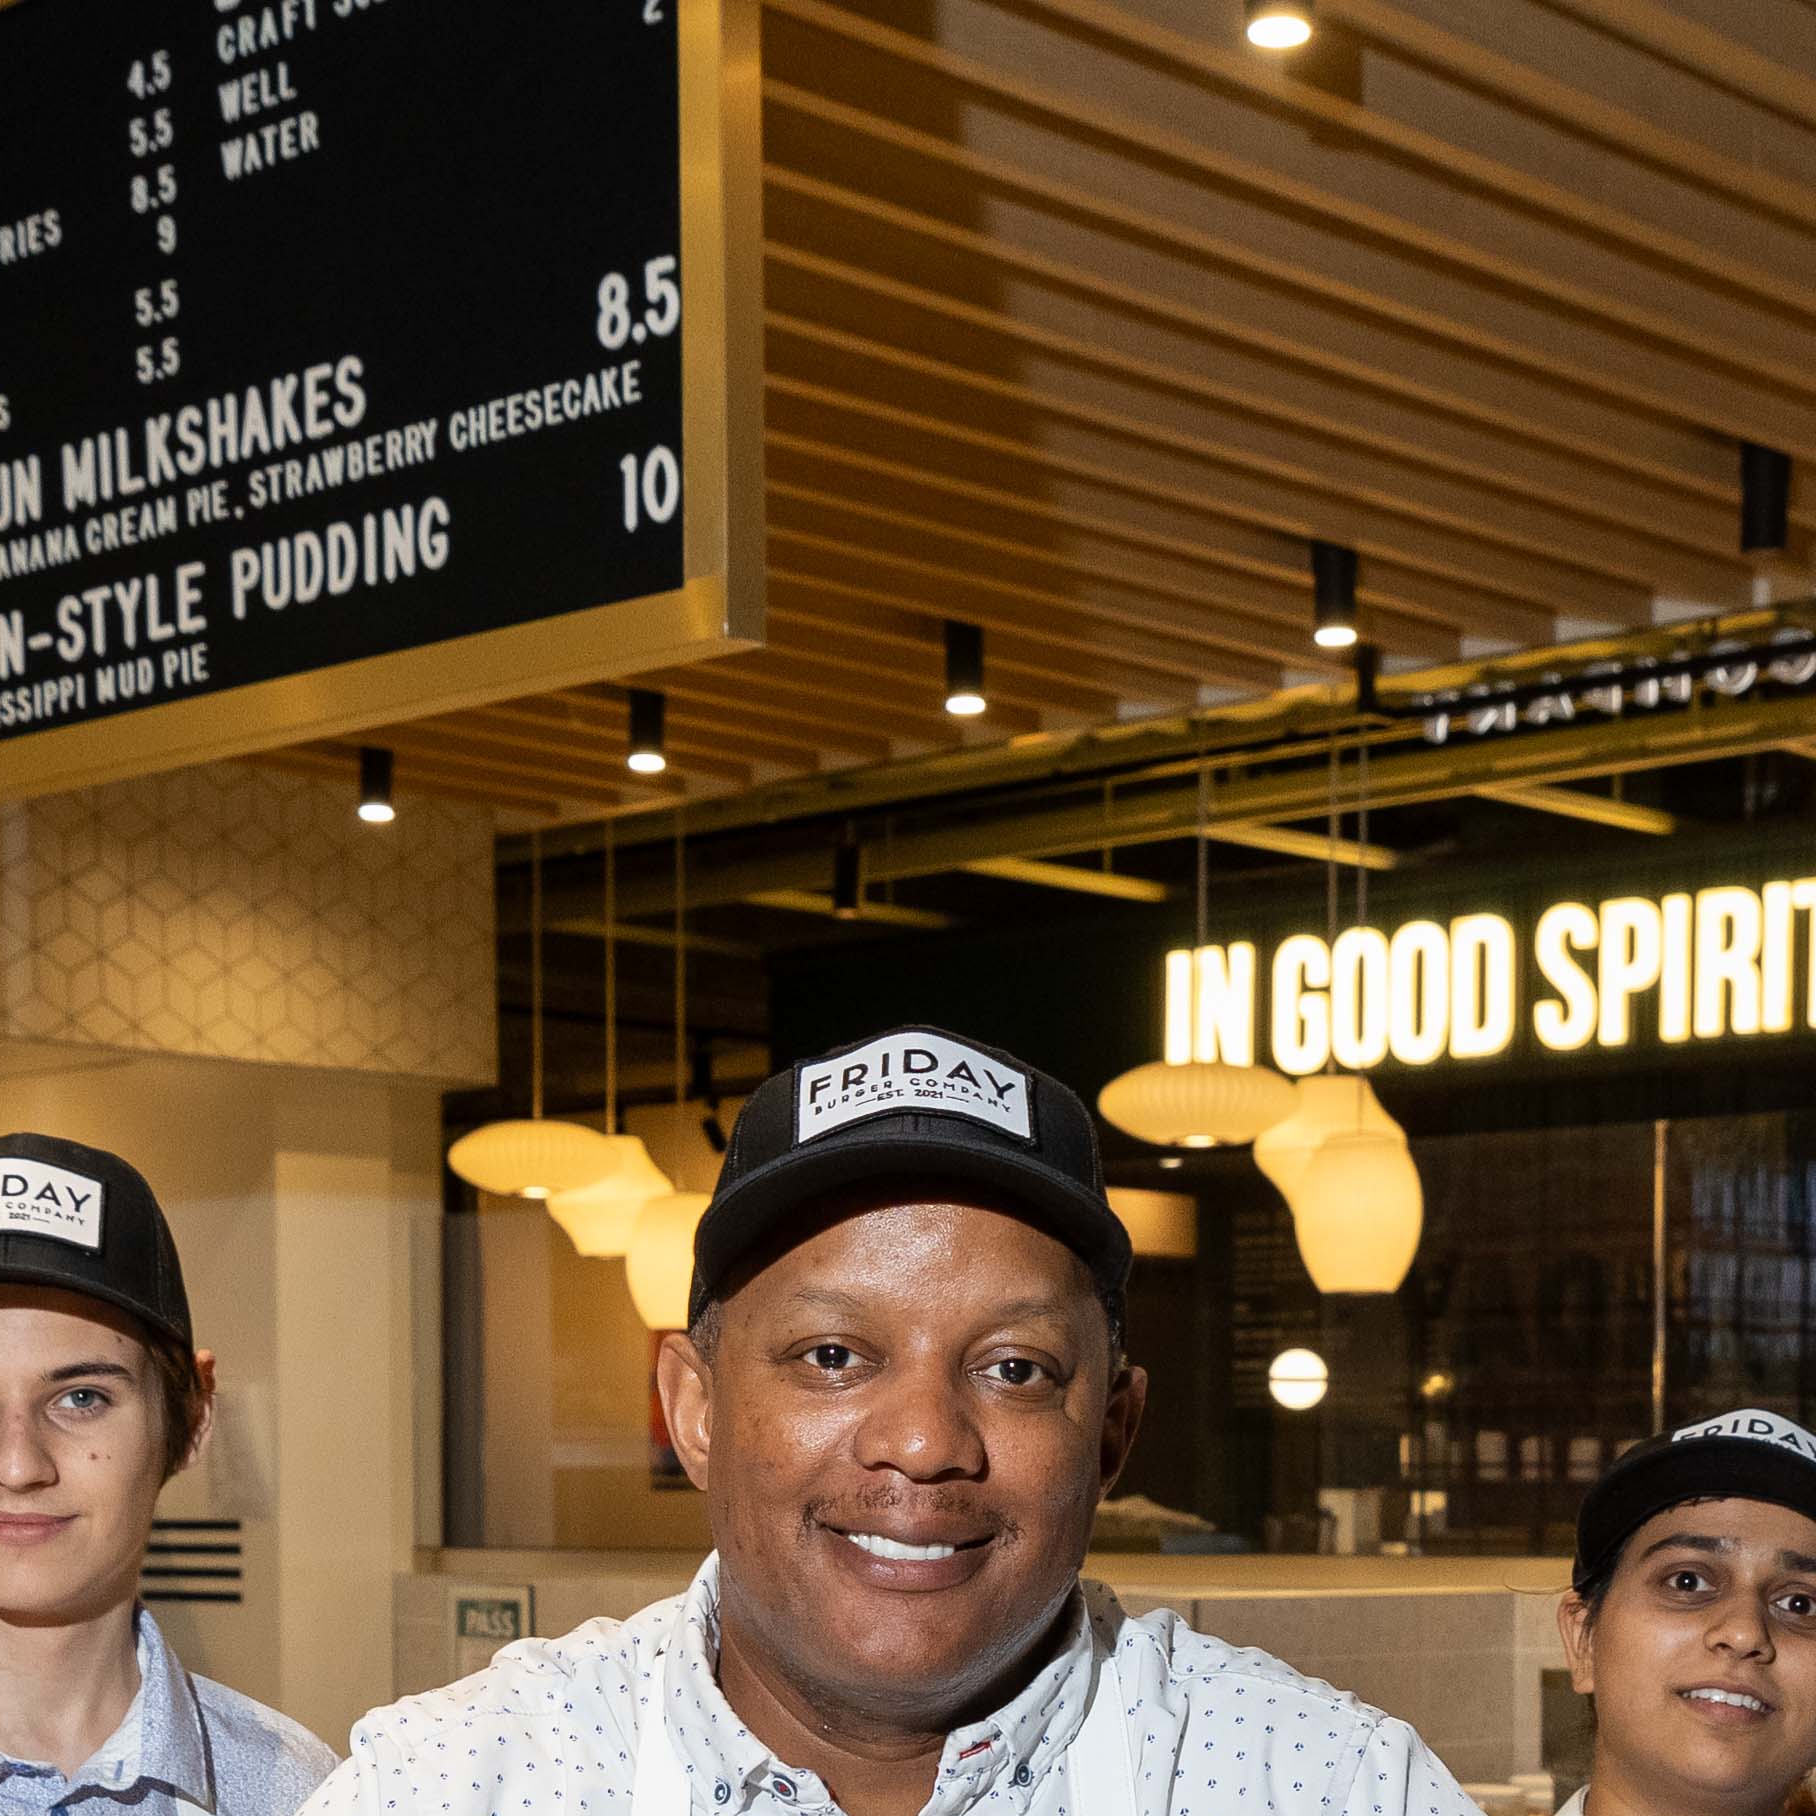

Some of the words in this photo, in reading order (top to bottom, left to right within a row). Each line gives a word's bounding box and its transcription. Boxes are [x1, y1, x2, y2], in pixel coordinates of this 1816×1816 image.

[217, 0, 317, 63] CRAFT
[128, 46, 171, 104] 4.5
[218, 62, 296, 122] WELL
[129, 103, 173, 161] 5.5
[221, 112, 319, 180] WATER
[131, 161, 176, 217] 8.5
[157, 211, 177, 258] 9
[135, 276, 179, 330] 5.5
[62, 351, 366, 515] MILKSHAKES
[596, 251, 680, 355] 8.5
[136, 335, 180, 388] 5.5
[85, 494, 177, 557] CREAM
[249, 419, 438, 511] STRAWBERRY
[450, 357, 642, 454] CHEESECAKE
[229, 492, 451, 622] PUDDING
[620, 440, 680, 535] 10
[95, 654, 155, 705] MUD
[163, 640, 210, 689] PIE
[1165, 942, 1255, 1069] IN
[1271, 912, 1515, 1076] GOOD
[810, 1049, 1015, 1104] FRIDAY
[814, 1081, 892, 1115] BURGER
[910, 1077, 1011, 1113] COMPANY
[914, 1088, 943, 1099] 2021
[5, 1201, 86, 1226] COMPANY
